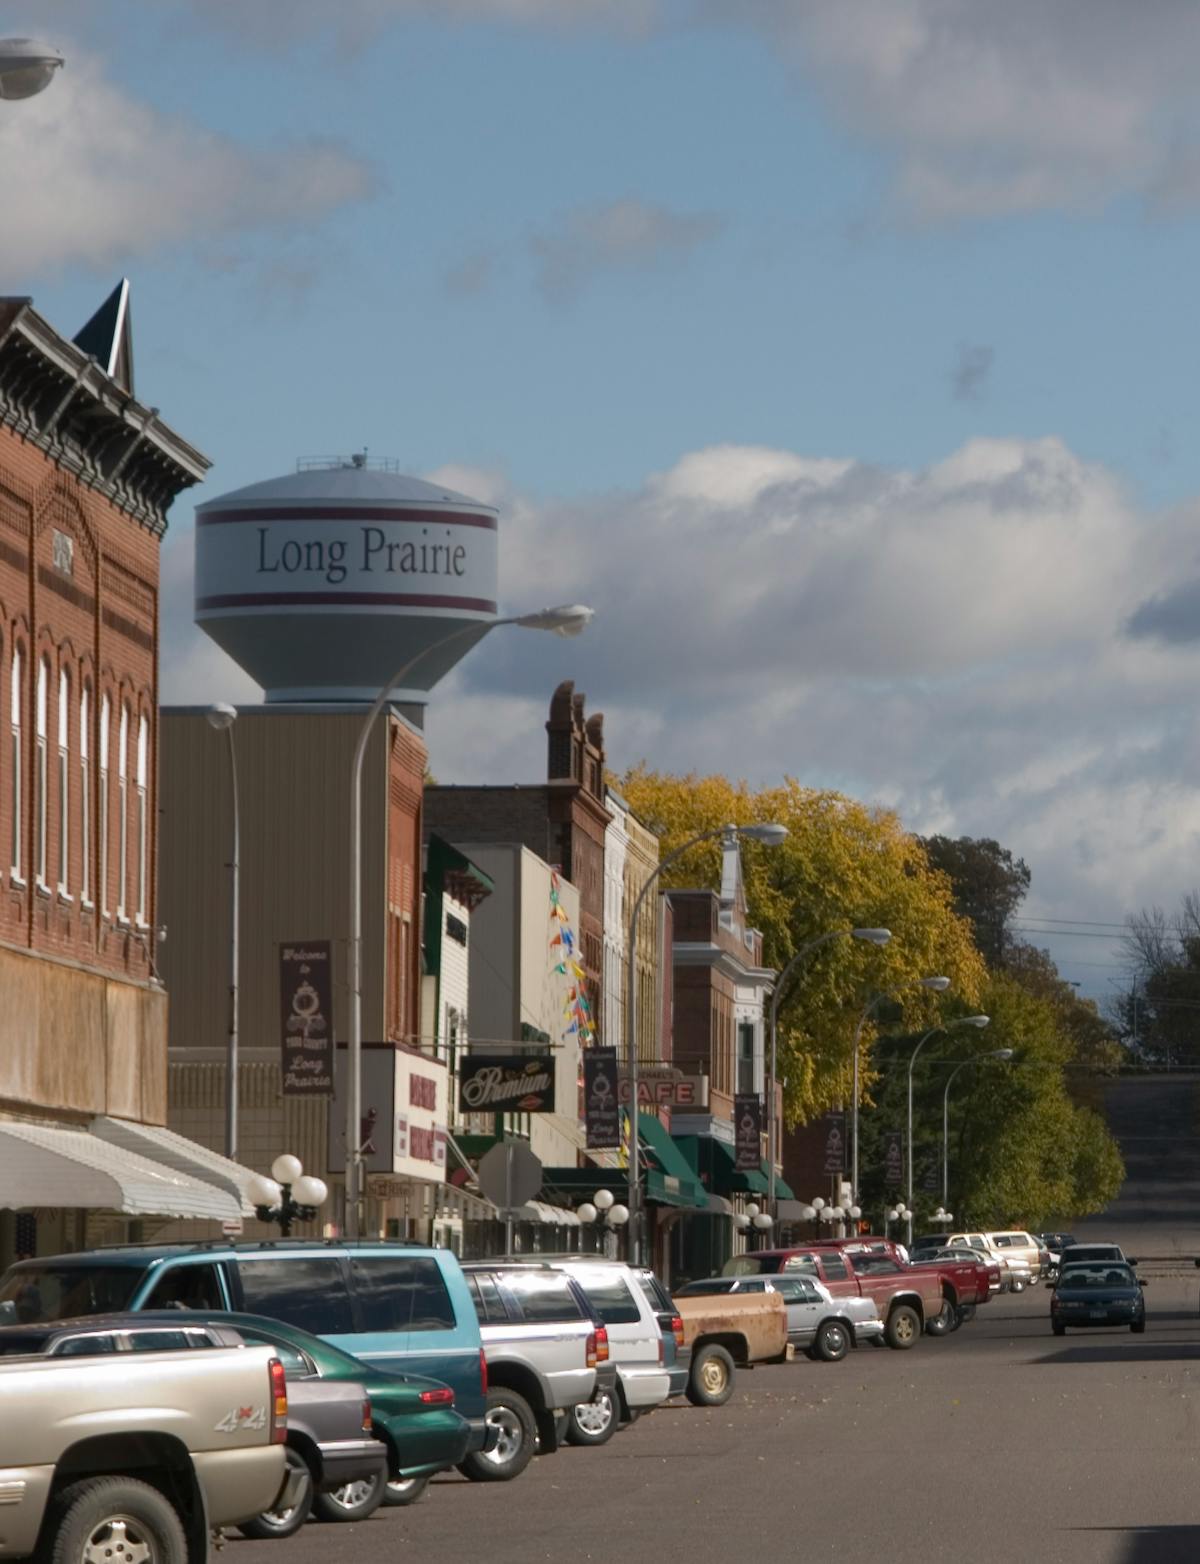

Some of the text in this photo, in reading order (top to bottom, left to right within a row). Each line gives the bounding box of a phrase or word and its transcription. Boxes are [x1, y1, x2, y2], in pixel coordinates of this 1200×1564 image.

[257, 527, 466, 584] Long Prairie
[282, 948, 327, 960] Welcome
[299, 964, 311, 974] to
[289, 1055, 324, 1074] Long
[284, 1072, 331, 1088] Prairie
[462, 1066, 551, 1107] Premium
[618, 1080, 696, 1105] CAFE
